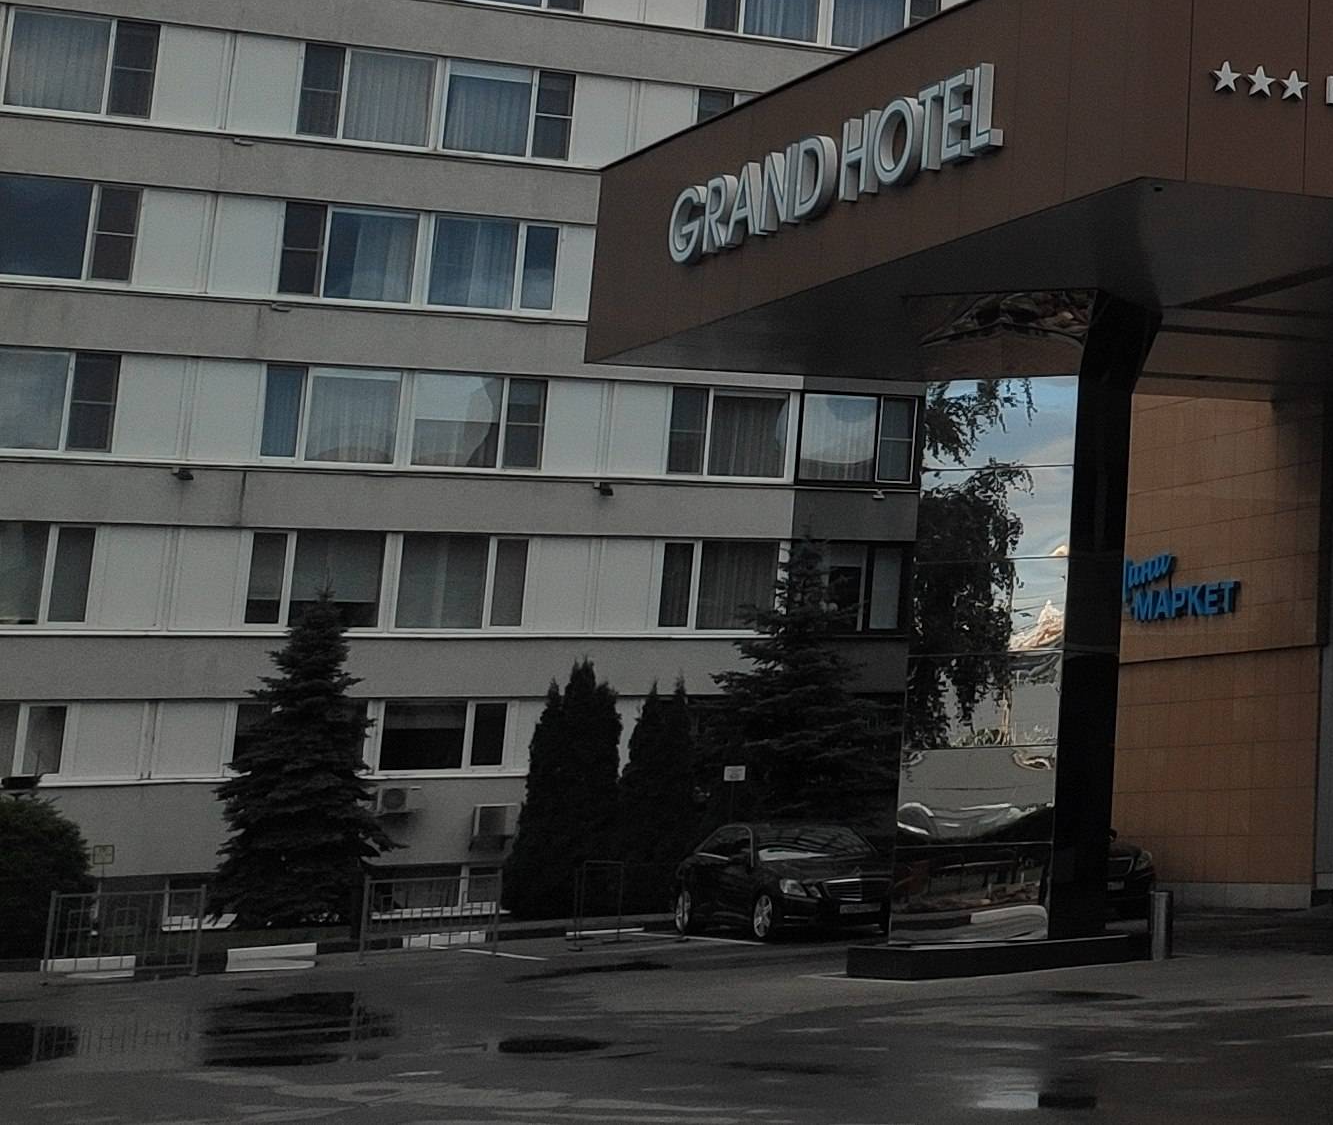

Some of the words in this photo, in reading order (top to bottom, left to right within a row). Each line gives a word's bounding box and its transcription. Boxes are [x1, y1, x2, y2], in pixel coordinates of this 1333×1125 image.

[668, 134, 839, 264] GRAND
[838, 62, 1004, 203] HOTEL
[1132, 579, 1241, 621] МАРКЕТ
